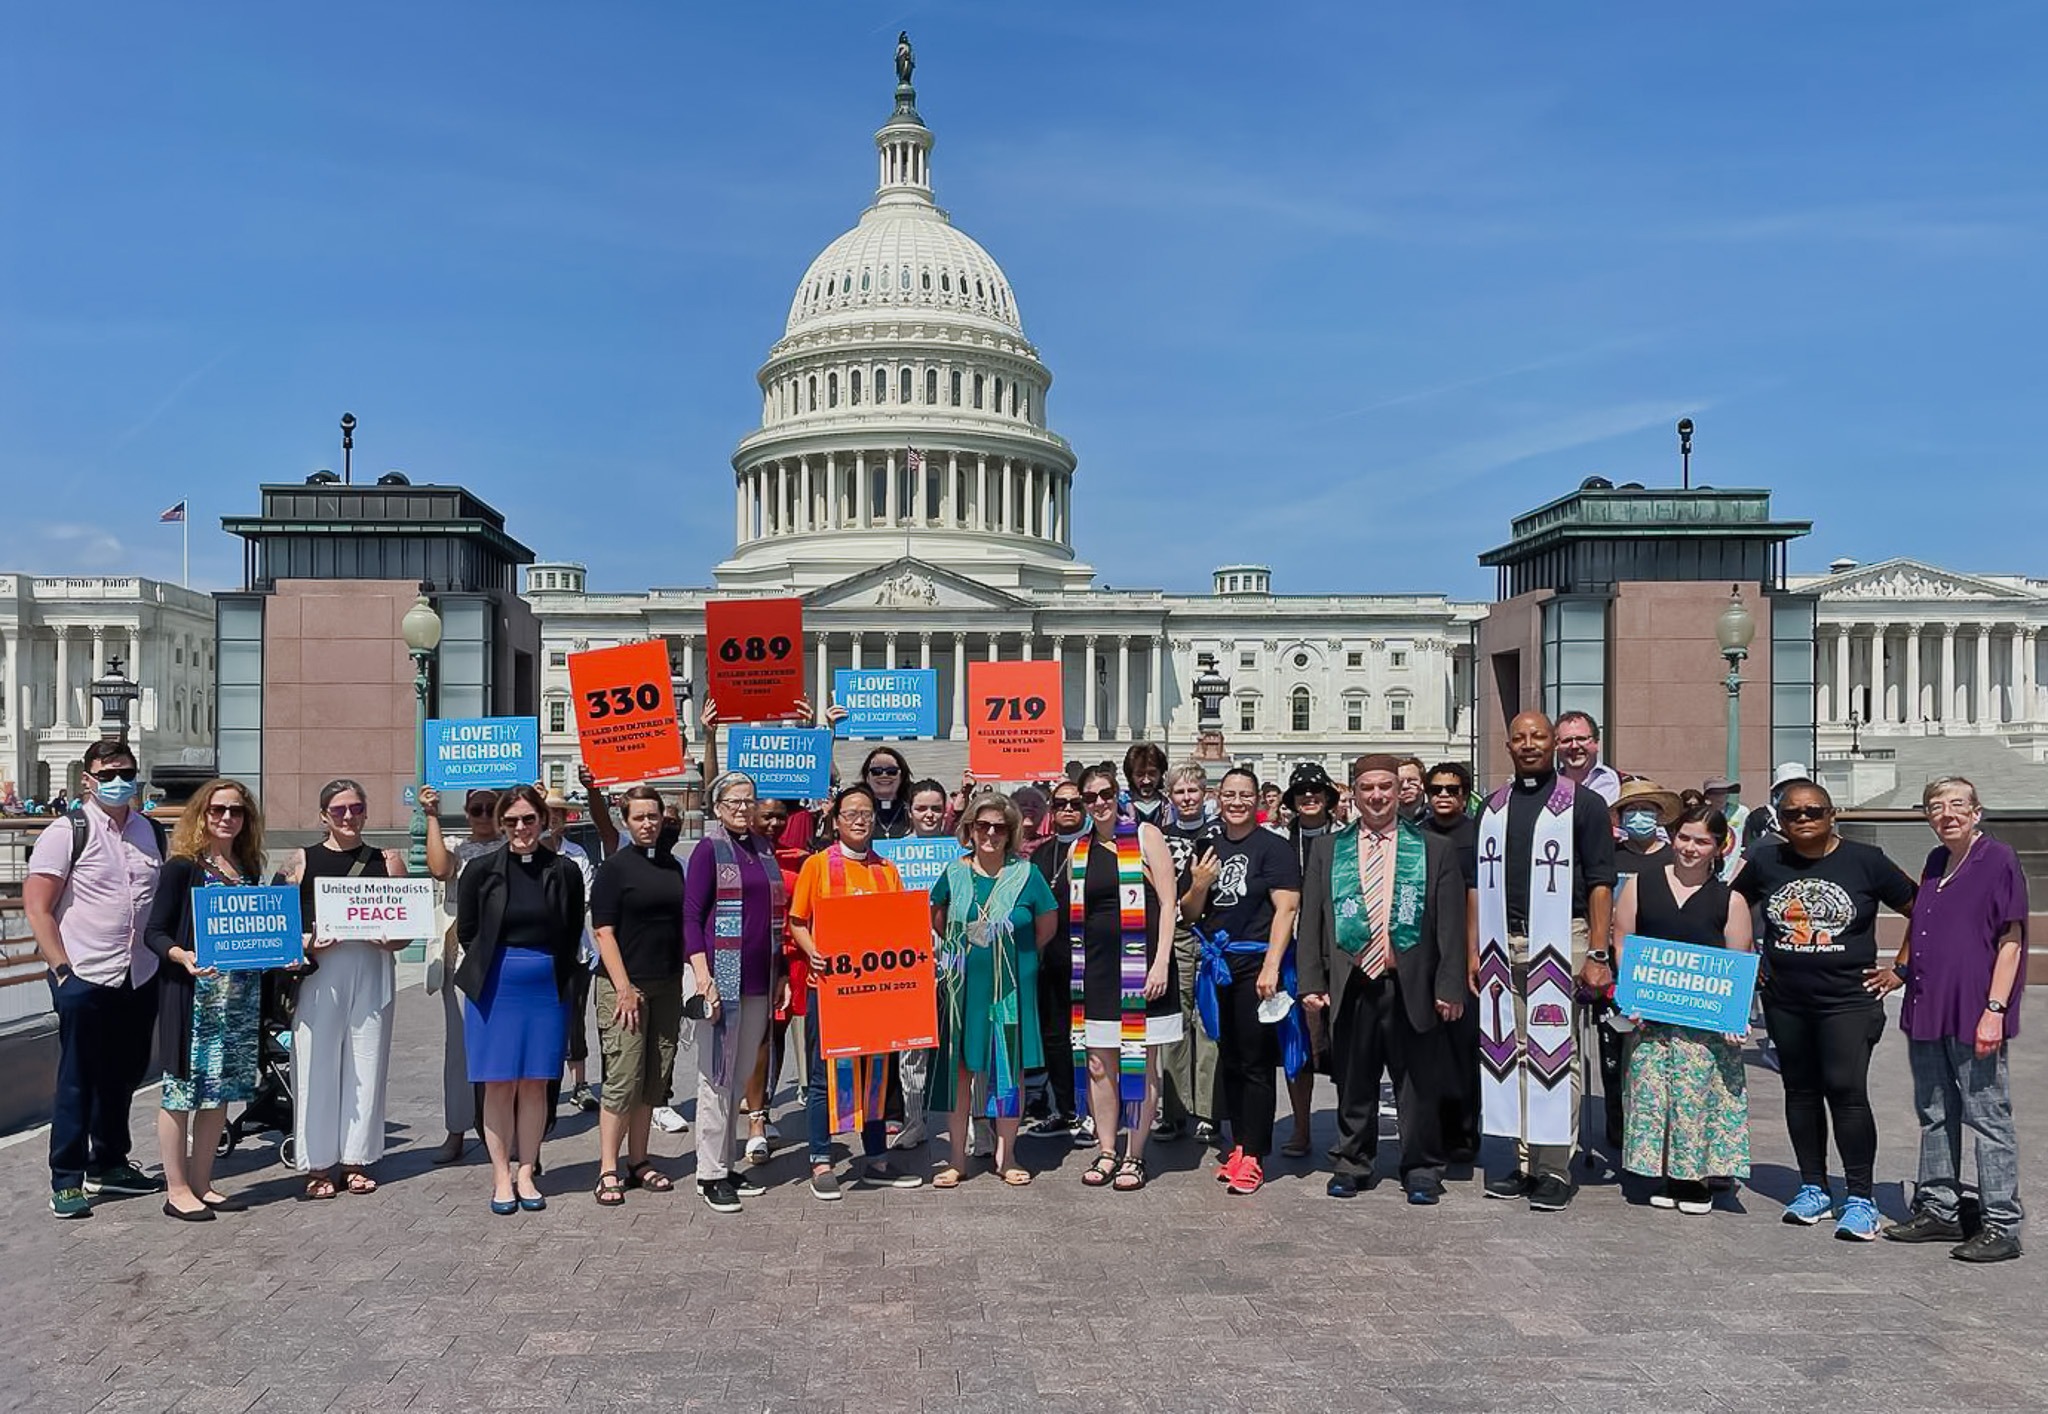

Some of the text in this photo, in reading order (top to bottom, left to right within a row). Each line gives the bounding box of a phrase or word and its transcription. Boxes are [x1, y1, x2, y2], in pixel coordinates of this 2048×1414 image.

[719, 636, 792, 662] 689
[586, 683, 660, 719] 330
[846, 693, 922, 708] NEIGHBOR
[985, 697, 1046, 721] 719
[582, 727, 612, 736] KILLED
[626, 720, 662, 730] INJURED
[439, 743, 522, 760] NEIGHBOR
[738, 753, 817, 769] NEIGHBOR
[896, 861, 948, 877] EIGHB
[321, 883, 429, 894] United Methodists
[349, 895, 403, 905] stand for
[347, 907, 407, 921] PEACE
[207, 915, 287, 935] NEIGHBOR
[823, 949, 928, 979] 18,000+
[837, 982, 917, 995] KILLED IN 2022
[1632, 965, 1734, 997] NEIGHBOR
